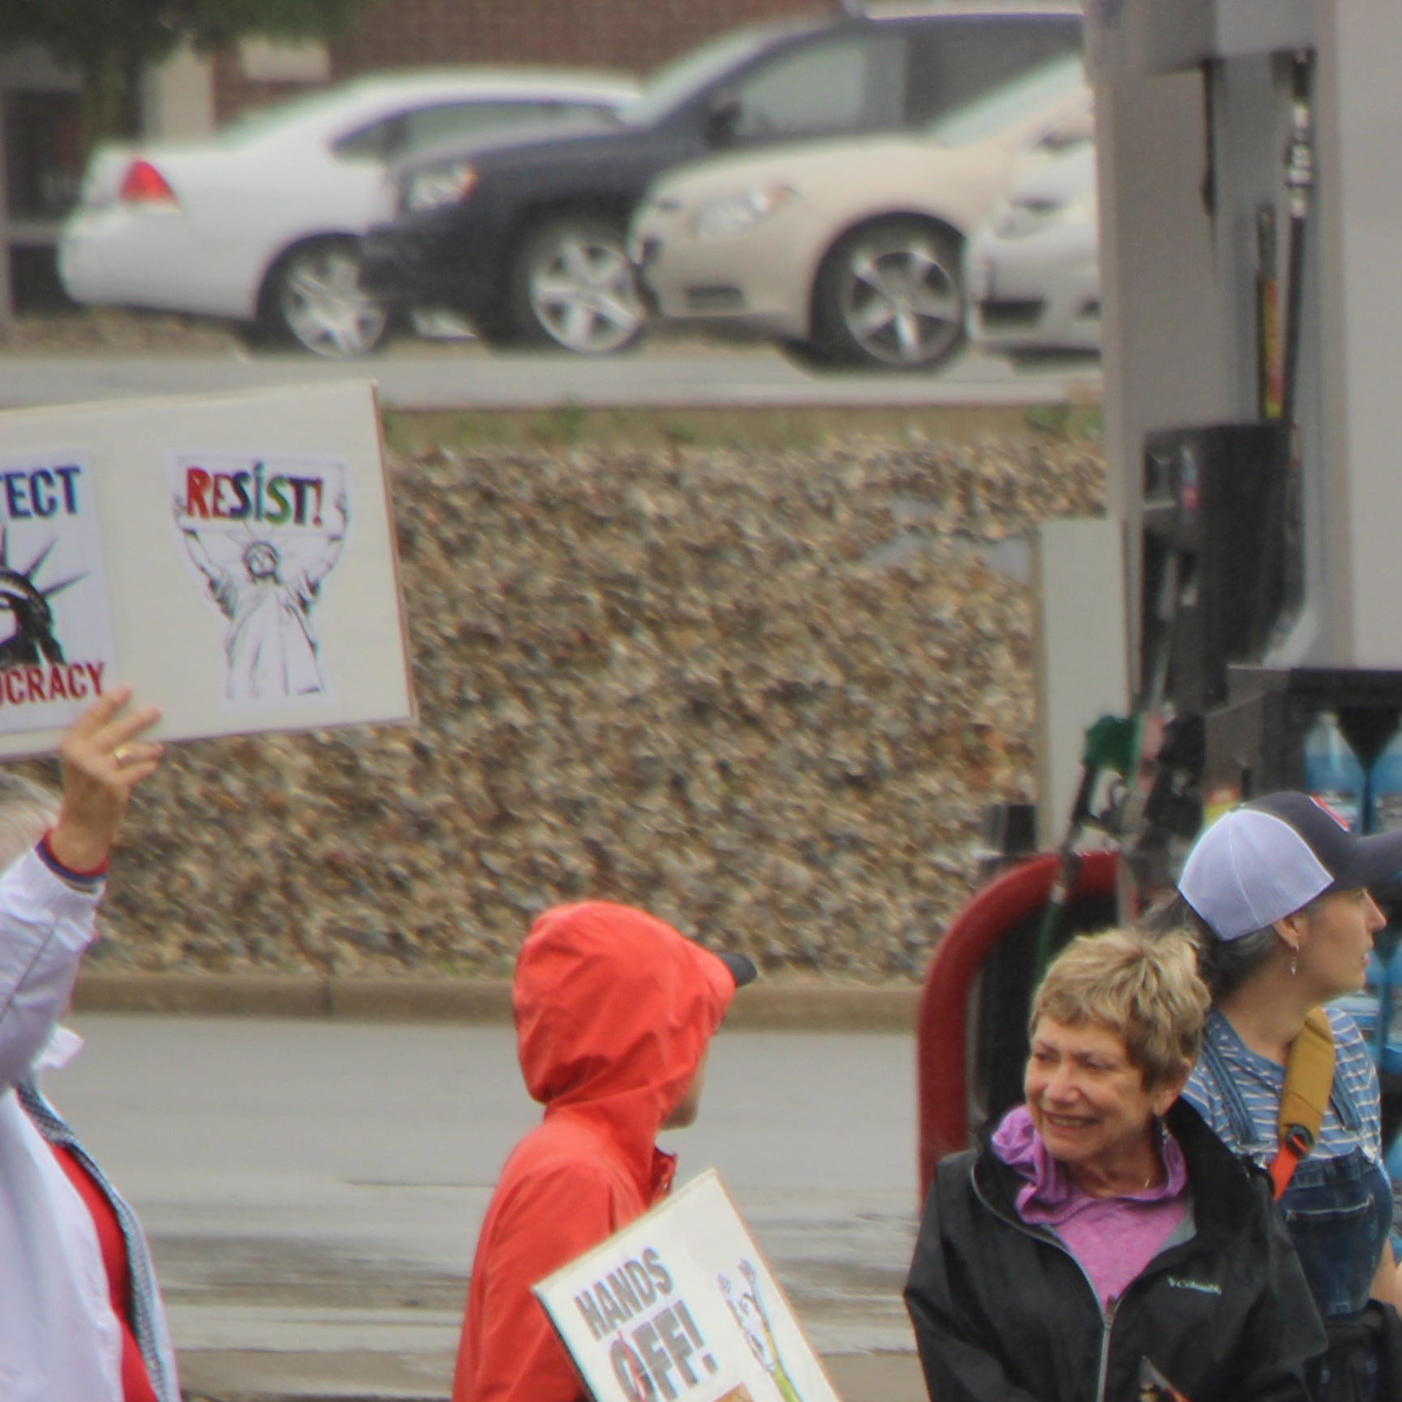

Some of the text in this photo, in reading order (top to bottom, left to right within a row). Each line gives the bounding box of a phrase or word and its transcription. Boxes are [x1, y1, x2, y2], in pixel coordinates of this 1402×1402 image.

[0, 464, 81, 520] ECT
[186, 460, 323, 527] RESIST!
[0, 660, 104, 707] CRACY
[575, 1246, 673, 1342] HANDS
